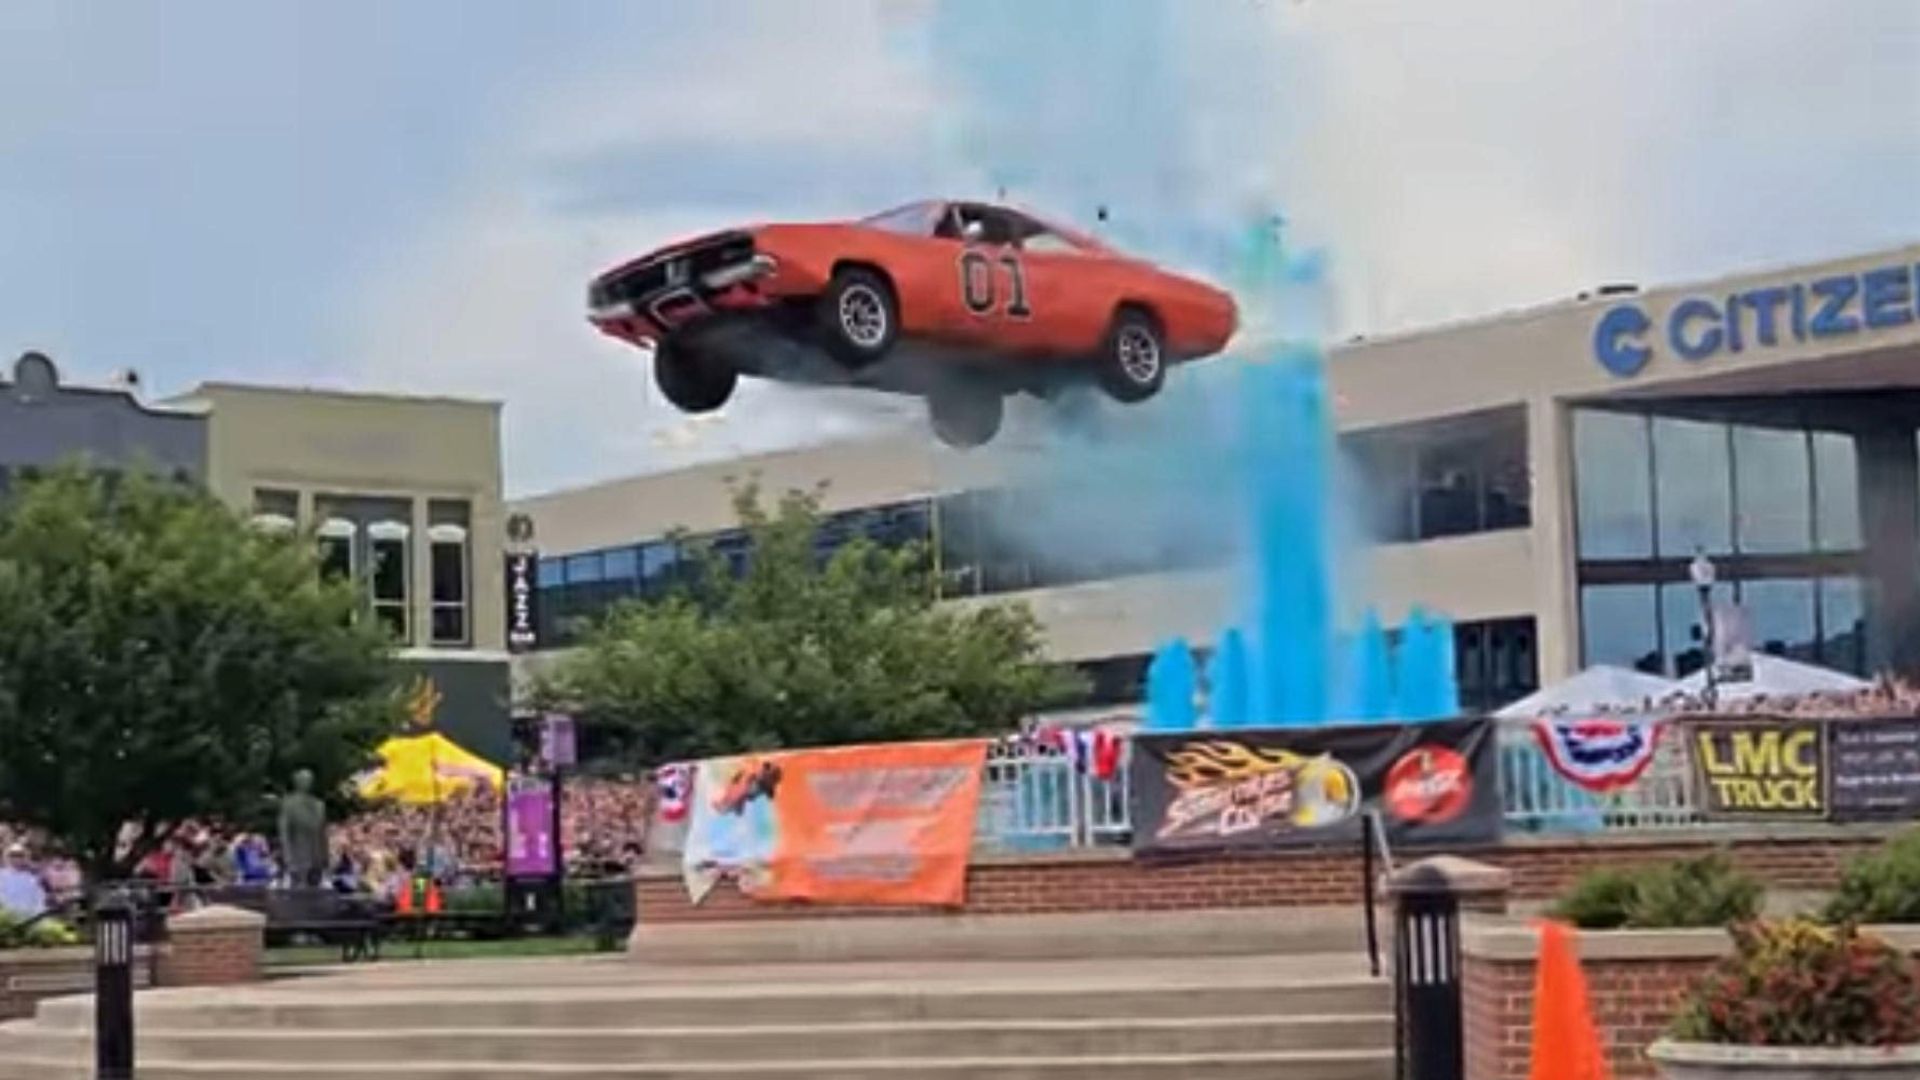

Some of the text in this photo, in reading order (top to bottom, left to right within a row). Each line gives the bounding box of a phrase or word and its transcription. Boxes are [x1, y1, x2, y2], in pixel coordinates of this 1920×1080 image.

[960, 250, 1031, 318] 01
[1668, 261, 1920, 362] CITIZE
[511, 555, 530, 629] JAZZ
[1697, 730, 1818, 776] LMC
[1711, 774, 1819, 810] TRUCK
